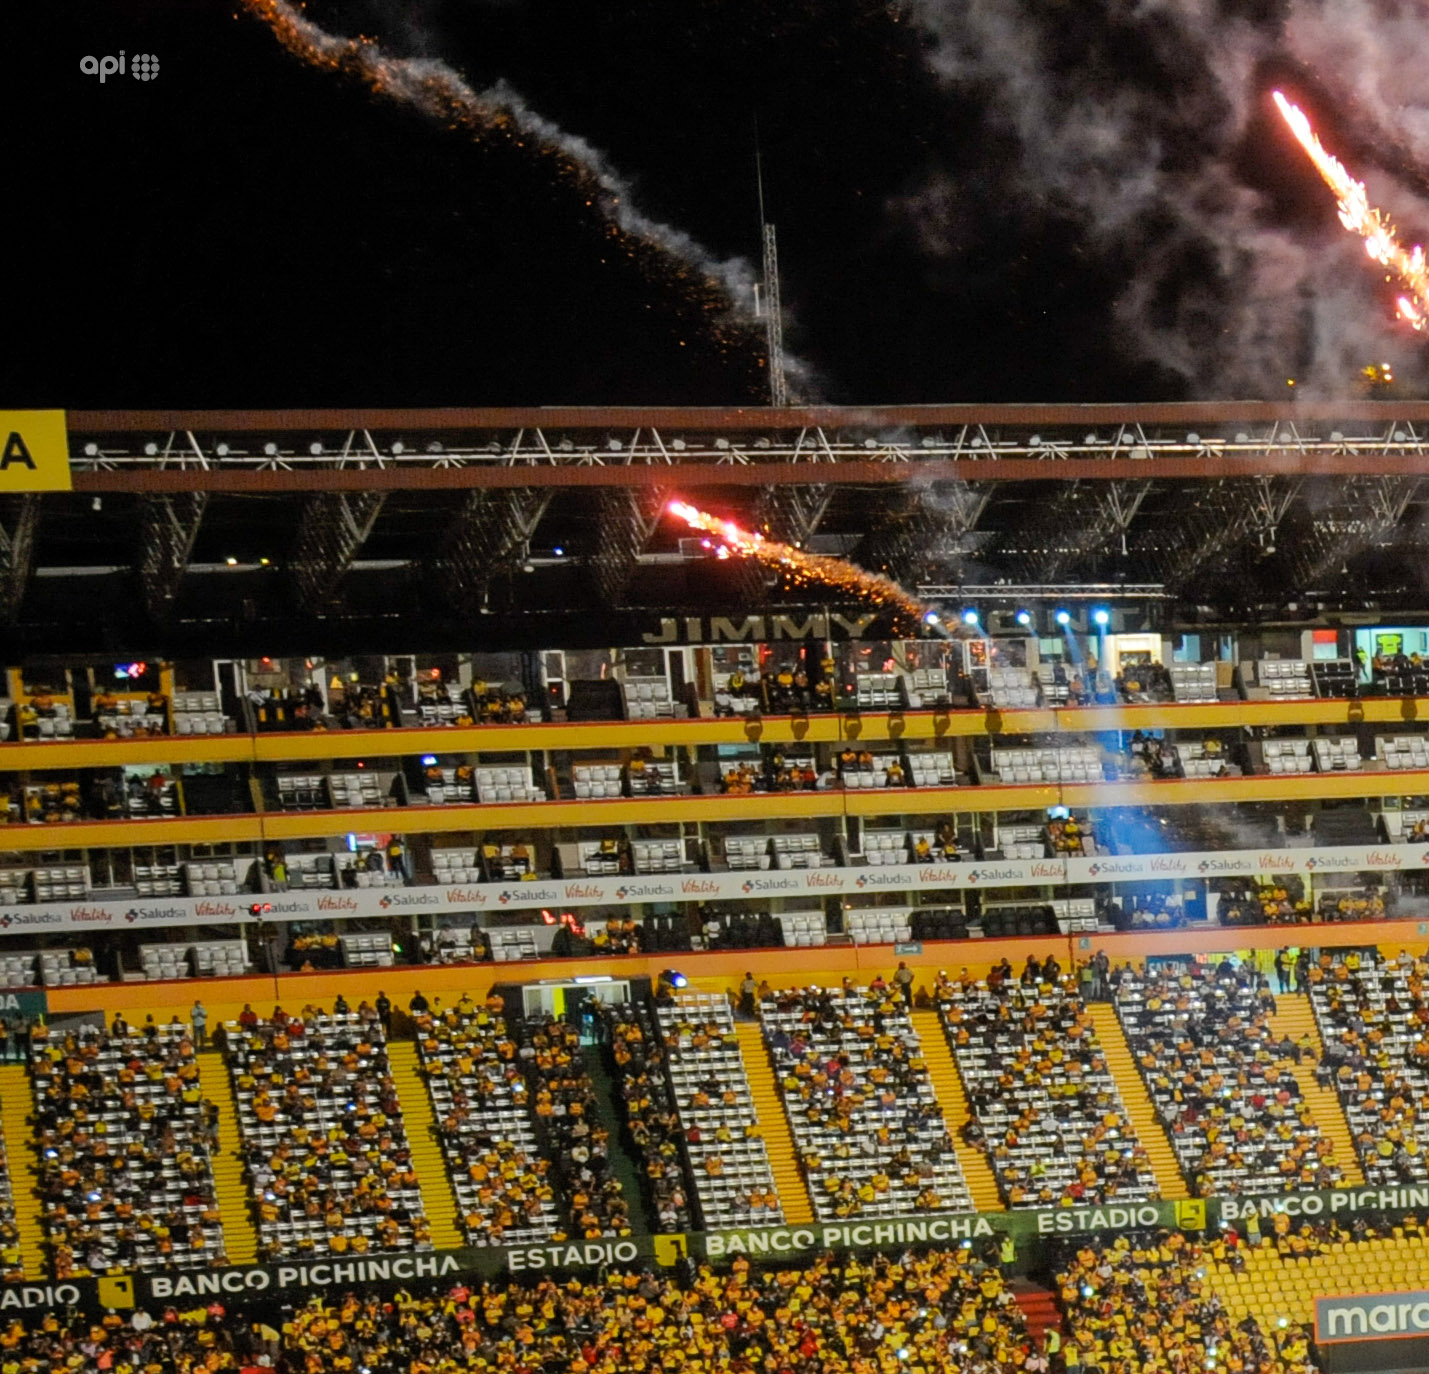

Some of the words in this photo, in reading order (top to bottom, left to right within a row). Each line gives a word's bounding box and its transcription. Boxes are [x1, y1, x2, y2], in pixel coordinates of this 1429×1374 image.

[0, 431, 37, 470] A
[642, 614, 878, 643] JIMMY
[1100, 863, 1143, 873] Saludsa
[1150, 857, 1186, 872] Vitality
[1210, 860, 1251, 870] Saludsa
[1258, 855, 1294, 870] Vitality
[1318, 857, 1359, 867] Saludsa
[1366, 852, 1402, 867] Vitality
[869, 874, 911, 885] Saludsa
[919, 868, 958, 884] Vitality
[981, 869, 1023, 880] Saludsa
[1030, 864, 1067, 879] Vitality
[629, 886, 674, 896] Saludsa
[681, 880, 721, 895] Vitality
[754, 879, 799, 891] Saludsa
[807, 873, 844, 888] Vitality
[394, 894, 439, 905] Saludsa
[447, 888, 488, 904] Vitality
[510, 890, 557, 901] Saludsa
[565, 884, 605, 899] Vitality
[138, 908, 186, 919] Saludsa
[195, 902, 237, 917] Vitality
[264, 902, 309, 913] aludsa
[317, 896, 359, 910] Vitality
[13, 912, 62, 924] Saludsa
[70, 909, 113, 923] Vitality
[1037, 1206, 1159, 1233] ESTADIO
[1221, 1195, 1323, 1221] BANCO
[508, 1242, 638, 1271] ESTADIO
[706, 1230, 815, 1256] BANCO
[823, 1217, 994, 1247] PICHINCHA
[151, 1270, 270, 1298] BANCO
[278, 1255, 460, 1288] PICHINCHA
